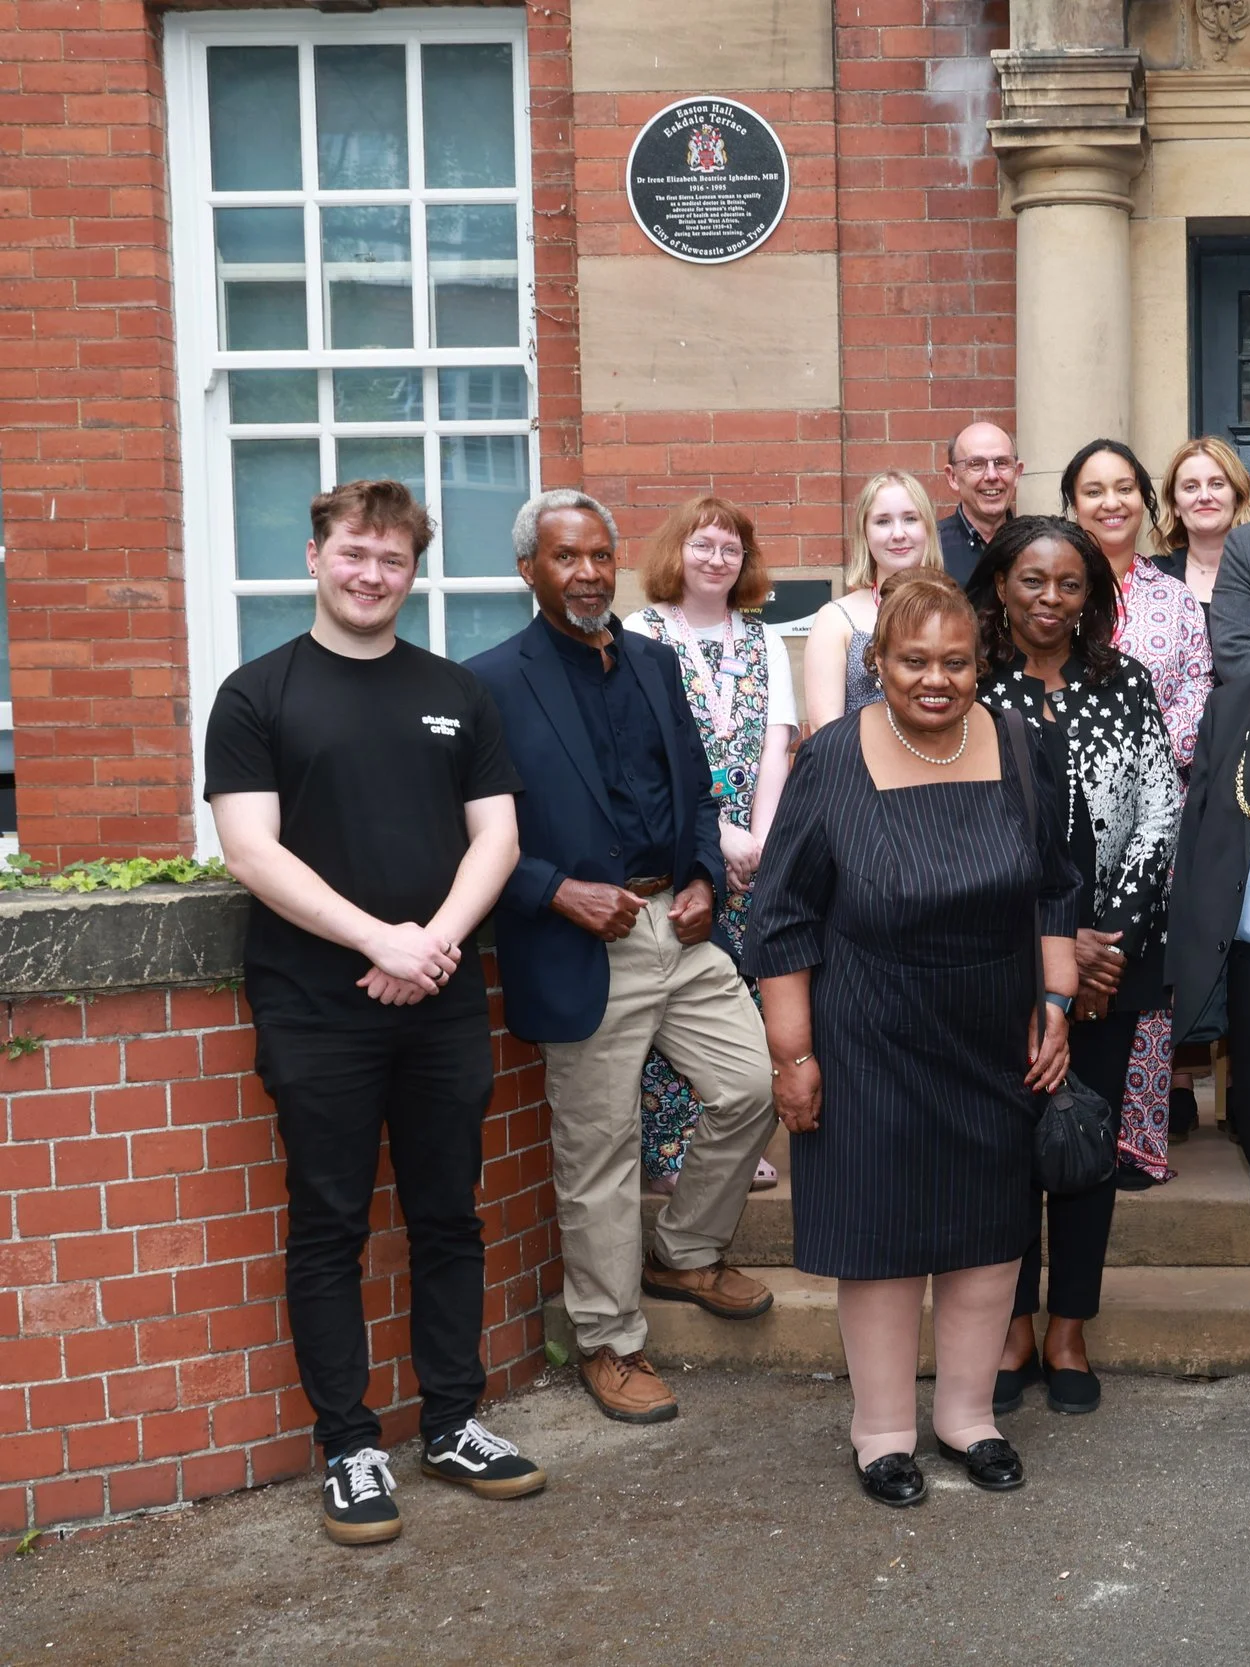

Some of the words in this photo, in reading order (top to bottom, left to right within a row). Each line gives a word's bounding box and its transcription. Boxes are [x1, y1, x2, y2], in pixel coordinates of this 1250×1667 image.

[676, 104, 708, 118] Easton
[712, 104, 735, 118] Hall,
[663, 115, 704, 138] Eskdale
[709, 113, 747, 136] Terrace
[667, 175, 697, 183] Elizabeth
[653, 224, 669, 242] City
[670, 239, 680, 248] of
[681, 243, 724, 255] Newcastle
[727, 239, 747, 253] upon
[746, 223, 765, 240] Tyne
[421, 715, 461, 728] student
[430, 724, 456, 736] cribs
